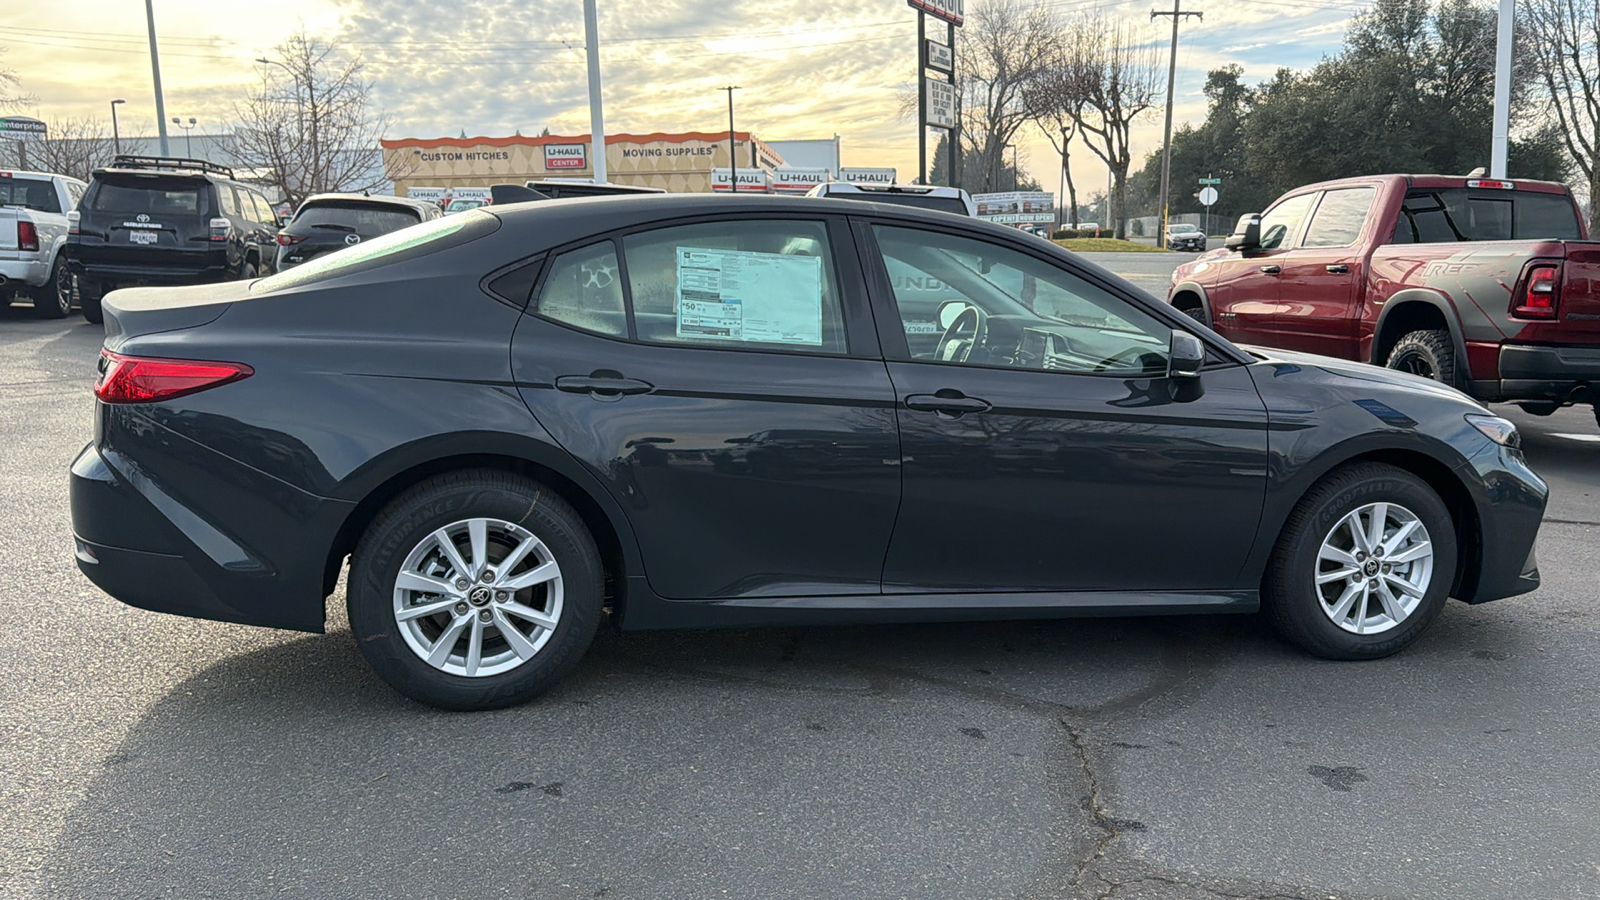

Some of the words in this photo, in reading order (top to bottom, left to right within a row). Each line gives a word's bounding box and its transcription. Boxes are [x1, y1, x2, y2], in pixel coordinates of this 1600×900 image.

[421, 152, 463, 162] CUSTOM
[465, 151, 509, 161] HITCHES
[548, 148, 582, 156] U-HAUL
[623, 148, 662, 158] MOVING
[666, 147, 712, 157] SUPPLIES
[780, 174, 823, 182] U-HAUL
[846, 173, 891, 182] U-HAUL
[1320, 482, 1393, 520] GOODYEAR
[377, 499, 456, 566] ASSURANCE
